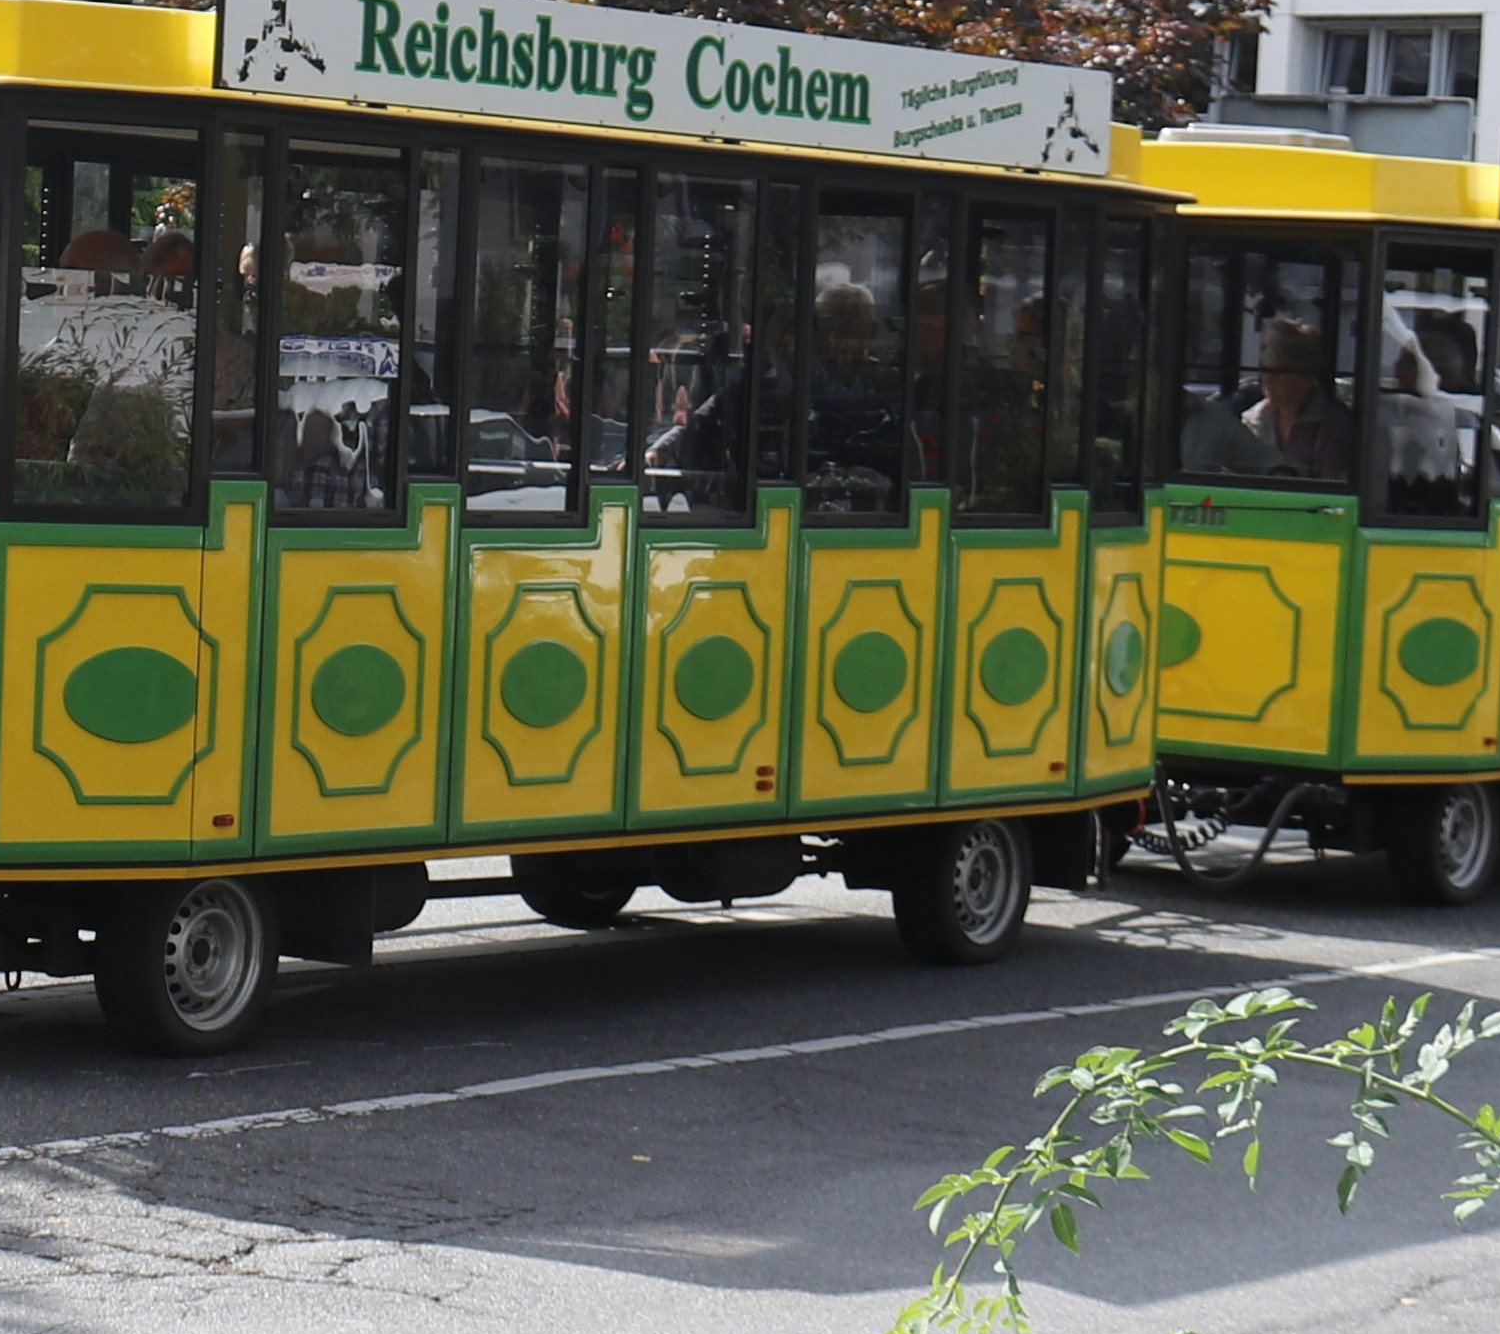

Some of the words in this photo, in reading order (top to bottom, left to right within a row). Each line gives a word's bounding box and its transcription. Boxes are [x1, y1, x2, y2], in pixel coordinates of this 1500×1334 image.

[685, 34, 872, 126] Cochem
[900, 83, 947, 110] Tägliche
[893, 115, 963, 148] Burgschenke
[979, 101, 1023, 125] Terrasse
